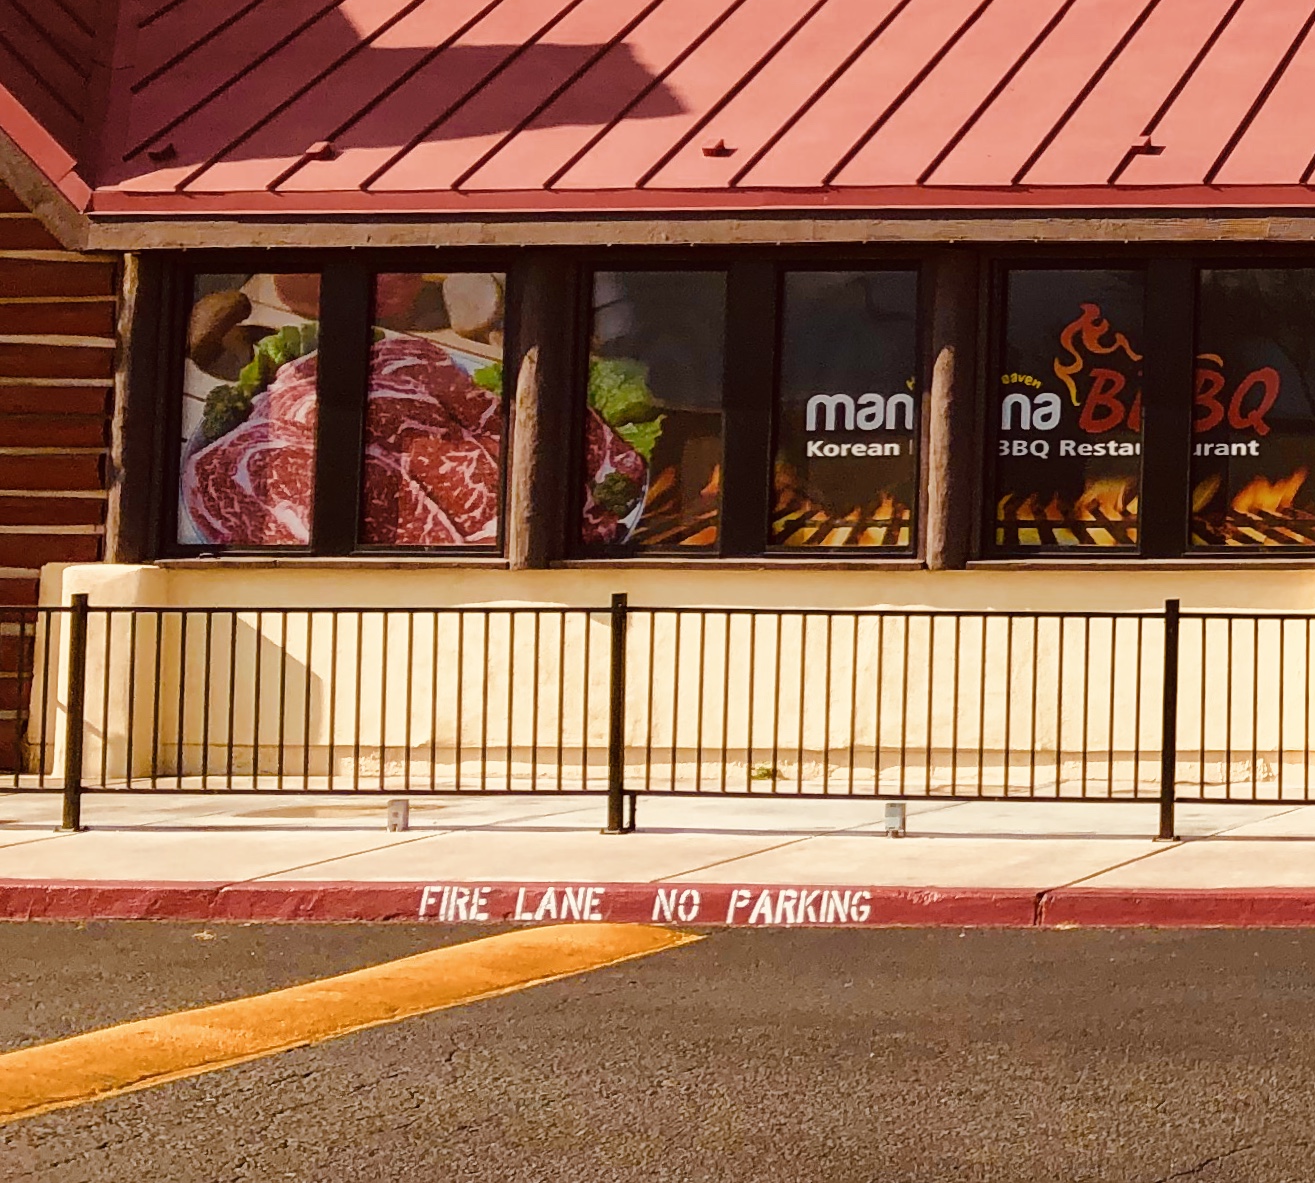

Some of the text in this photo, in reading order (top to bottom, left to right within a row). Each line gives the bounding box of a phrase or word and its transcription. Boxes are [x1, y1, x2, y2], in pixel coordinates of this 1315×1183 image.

[806, 440, 900, 457] Korean
[419, 885, 873, 925] FIRE LANE NO PARKING
